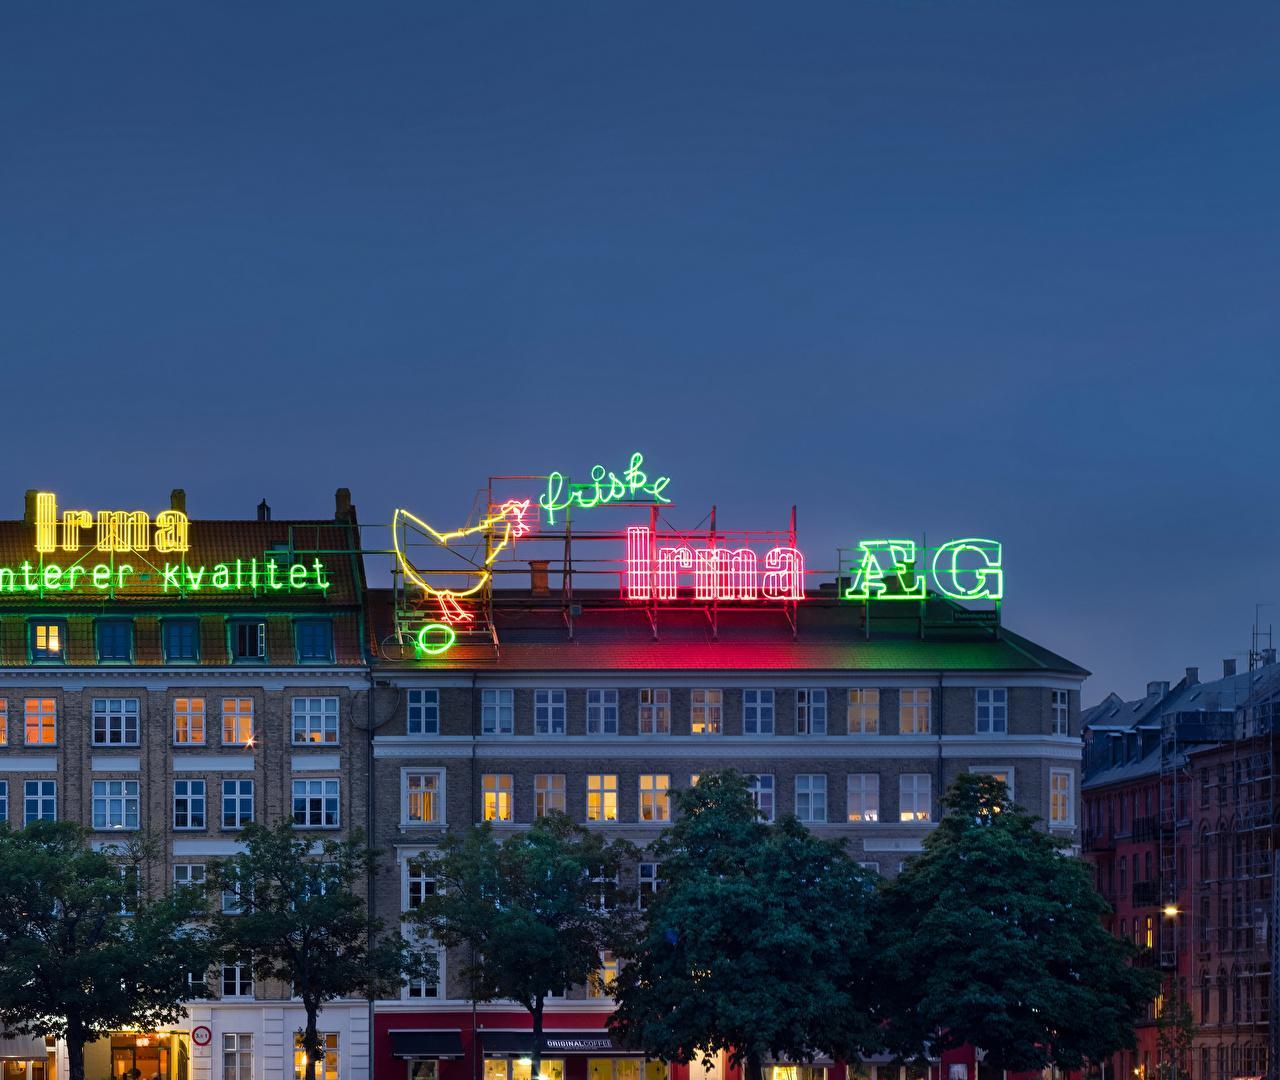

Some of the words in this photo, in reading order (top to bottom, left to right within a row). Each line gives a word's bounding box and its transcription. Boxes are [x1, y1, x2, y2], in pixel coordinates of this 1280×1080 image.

[539, 451, 672, 526] friske
[35, 492, 190, 553] Irma
[162, 557, 331, 593] kvalitet
[625, 525, 807, 601] Irma
[846, 538, 1004, 601] ÆG
